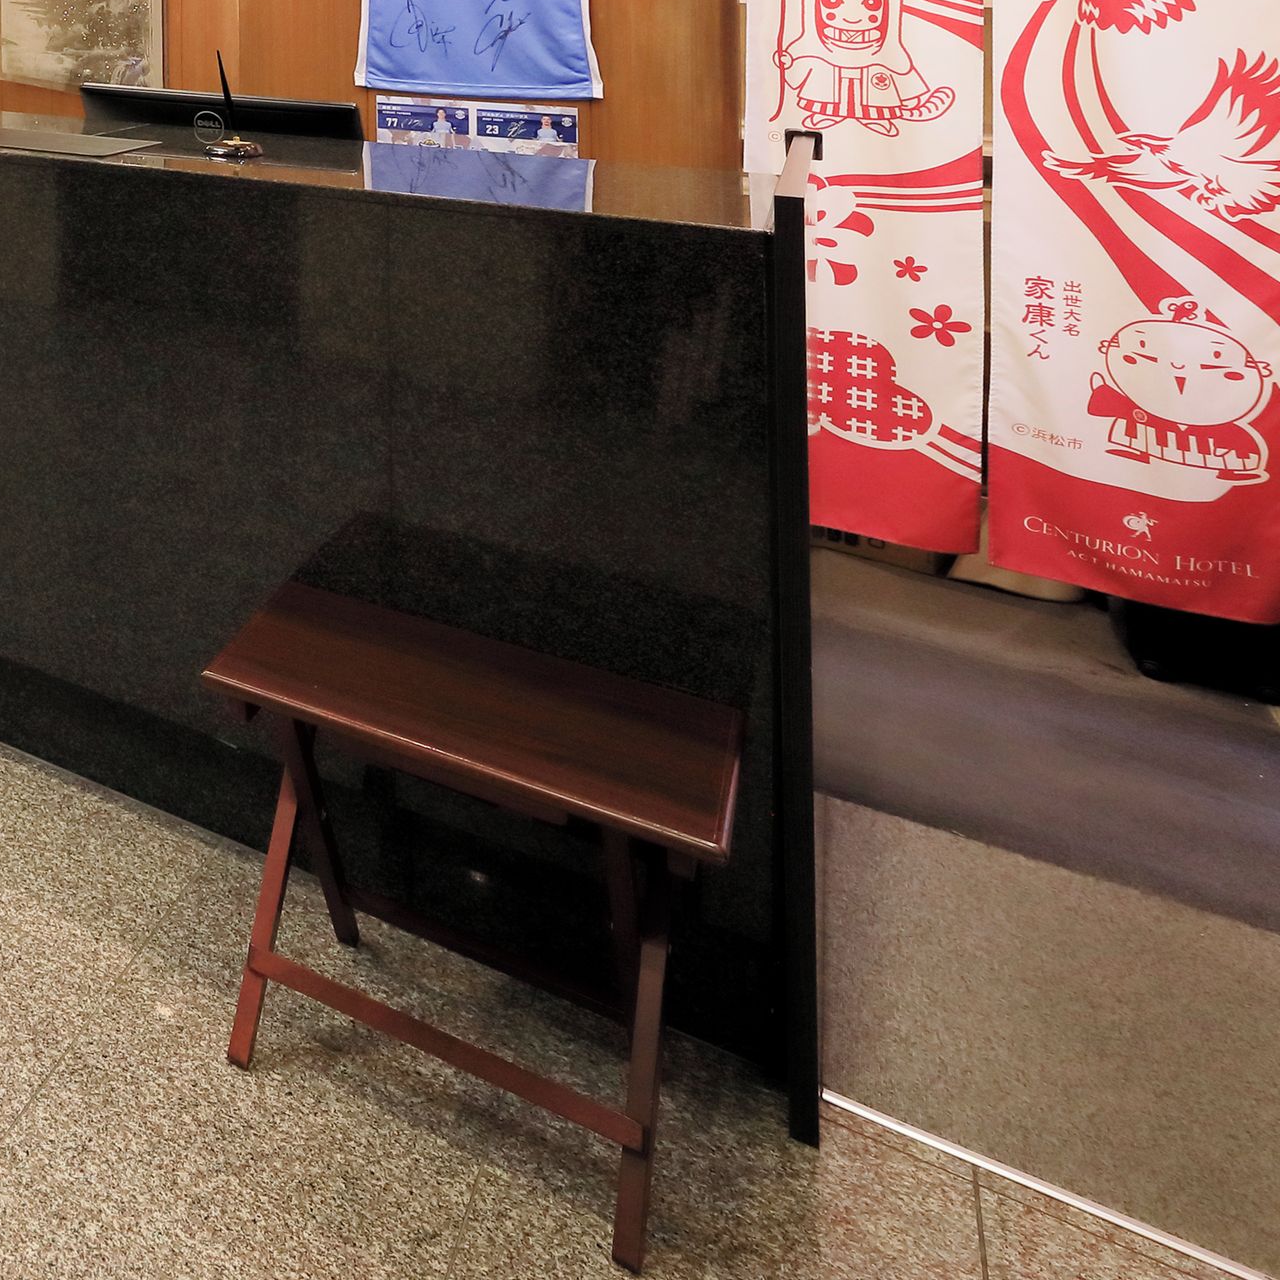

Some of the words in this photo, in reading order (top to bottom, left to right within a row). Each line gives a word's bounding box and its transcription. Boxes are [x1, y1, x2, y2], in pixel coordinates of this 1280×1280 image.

[196, 119, 222, 129] DELL
[385, 117, 399, 127] 77
[485, 124, 500, 135] 23
[1022, 275, 1056, 360] 家康くん
[1062, 280, 1083, 337] 出世大名
[1023, 515, 1160, 566] CENTURION
[1175, 554, 1261, 580] HOTEL
[1105, 562, 1213, 588] HAMAMATSU
